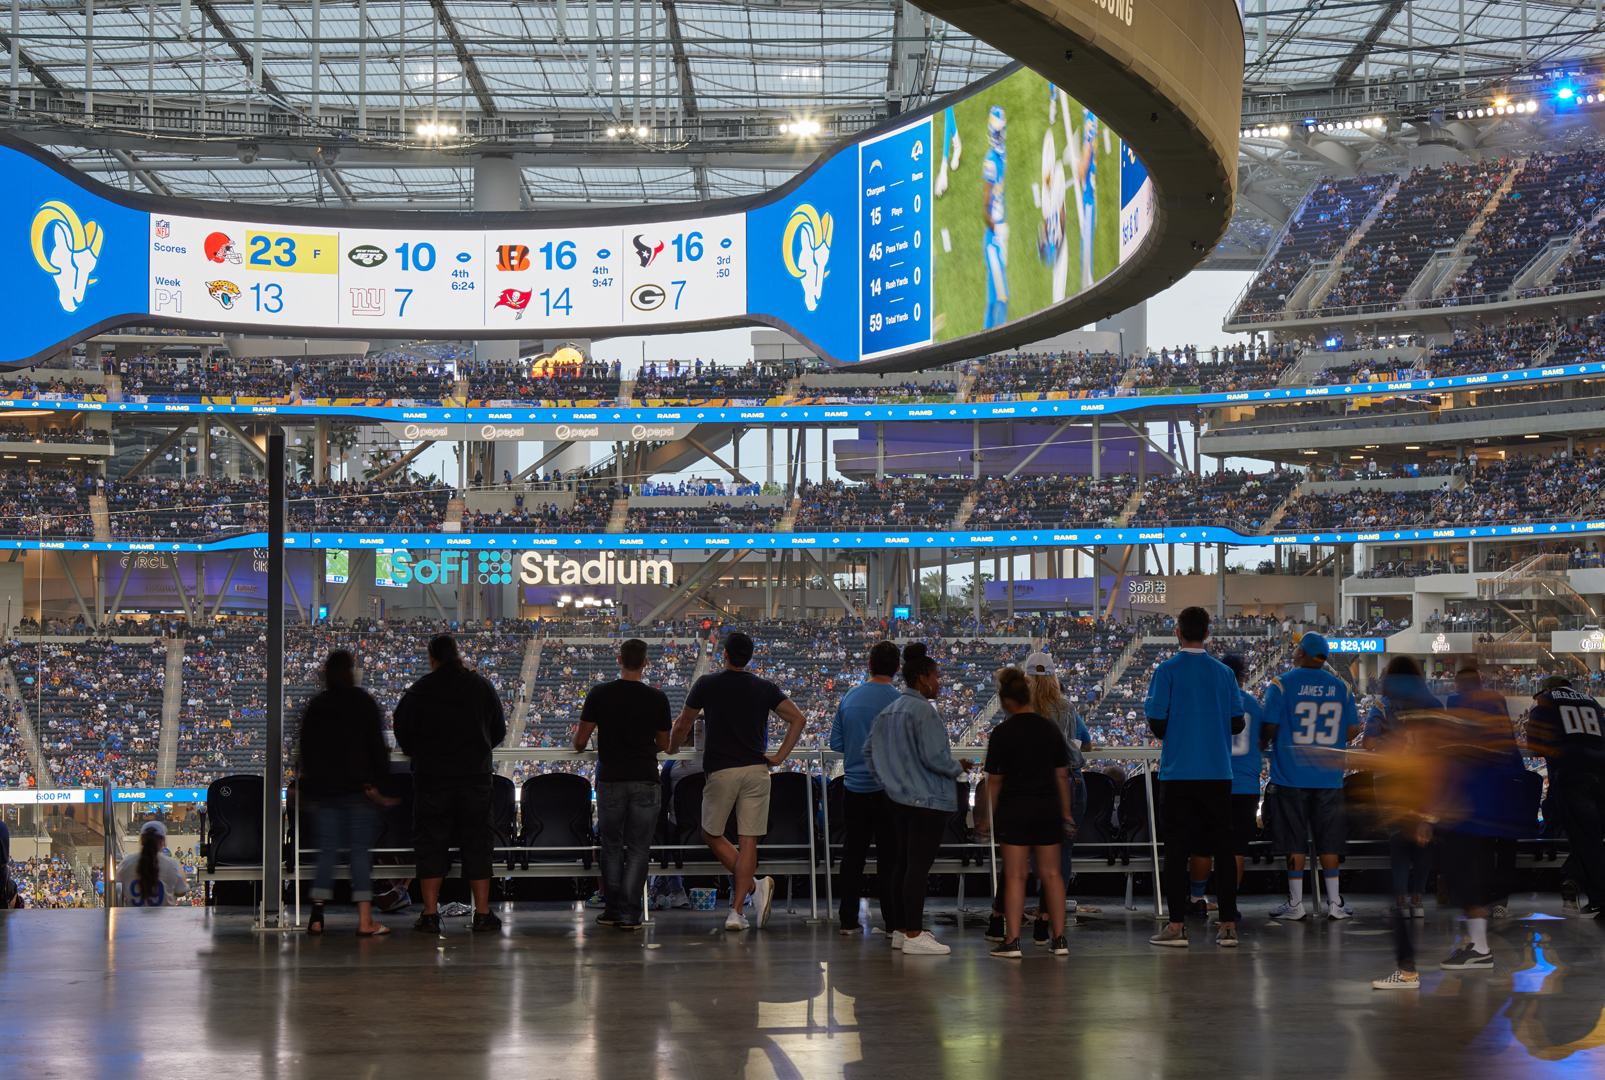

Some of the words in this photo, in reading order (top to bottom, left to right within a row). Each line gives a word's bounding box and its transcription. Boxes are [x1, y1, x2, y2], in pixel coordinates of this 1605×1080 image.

[912, 172, 923, 181] Rams
[866, 185, 886, 197] Chargers
[914, 194, 921, 213] 0
[870, 206, 882, 226] 15
[891, 207, 903, 216] Plays
[156, 226, 169, 237] NFL
[914, 230, 921, 249] 0
[154, 242, 187, 254] Scores
[249, 235, 297, 267] 23
[313, 249, 321, 259] F
[671, 231, 704, 263] 16
[869, 242, 882, 261] 45
[885, 245, 896, 254] Pass
[896, 241, 909, 251] Yards
[352, 252, 383, 261] JETS
[395, 242, 437, 272] 10
[539, 240, 577, 270] 16
[716, 256, 731, 265] 3rd
[450, 269, 469, 278] 4th
[592, 266, 609, 275] 4th
[716, 268, 730, 278] :50
[914, 266, 921, 285] 0
[155, 276, 181, 287] Week
[451, 281, 475, 291] 6:24
[592, 278, 614, 288] 9:47
[870, 278, 882, 297] 14
[885, 280, 896, 290] Rush
[896, 276, 909, 287] Yards
[154, 288, 183, 313] P1
[249, 282, 284, 313] 13
[539, 287, 573, 317] 14
[671, 280, 687, 311] 7
[394, 288, 414, 317] 7
[914, 302, 921, 321] 0
[869, 312, 882, 333] 59
[885, 316, 896, 325] Total
[896, 312, 909, 323] Yards
[1305, 387, 1329, 395] RAMS
[1387, 382, 1412, 390] RAMS
[1466, 375, 1488, 384] RAMS
[1541, 367, 1565, 377] RAMS
[419, 427, 448, 438] pepsi
[497, 427, 525, 438] pepsi
[570, 427, 599, 438] pepsi
[646, 426, 675, 438] pepsi
[1273, 536, 1297, 544] RAMS
[1357, 533, 1380, 541] RAMS
[1433, 529, 1455, 537] RAMS
[1510, 525, 1534, 534] RAMS
[1586, 522, 1605, 530] RAMS
[390, 551, 468, 585] SoFi
[520, 551, 674, 585] Stadium
[1129, 581, 1153, 593] SoFi
[1129, 594, 1166, 604] CIRCLE
[1340, 640, 1377, 652] $29,140
[1297, 685, 1324, 697] JAMES
[1325, 685, 1336, 697] JR
[1292, 702, 1343, 745] 33
[1559, 705, 1602, 737] 08
[36, 792, 55, 800] 6:00
[57, 792, 71, 800] PM
